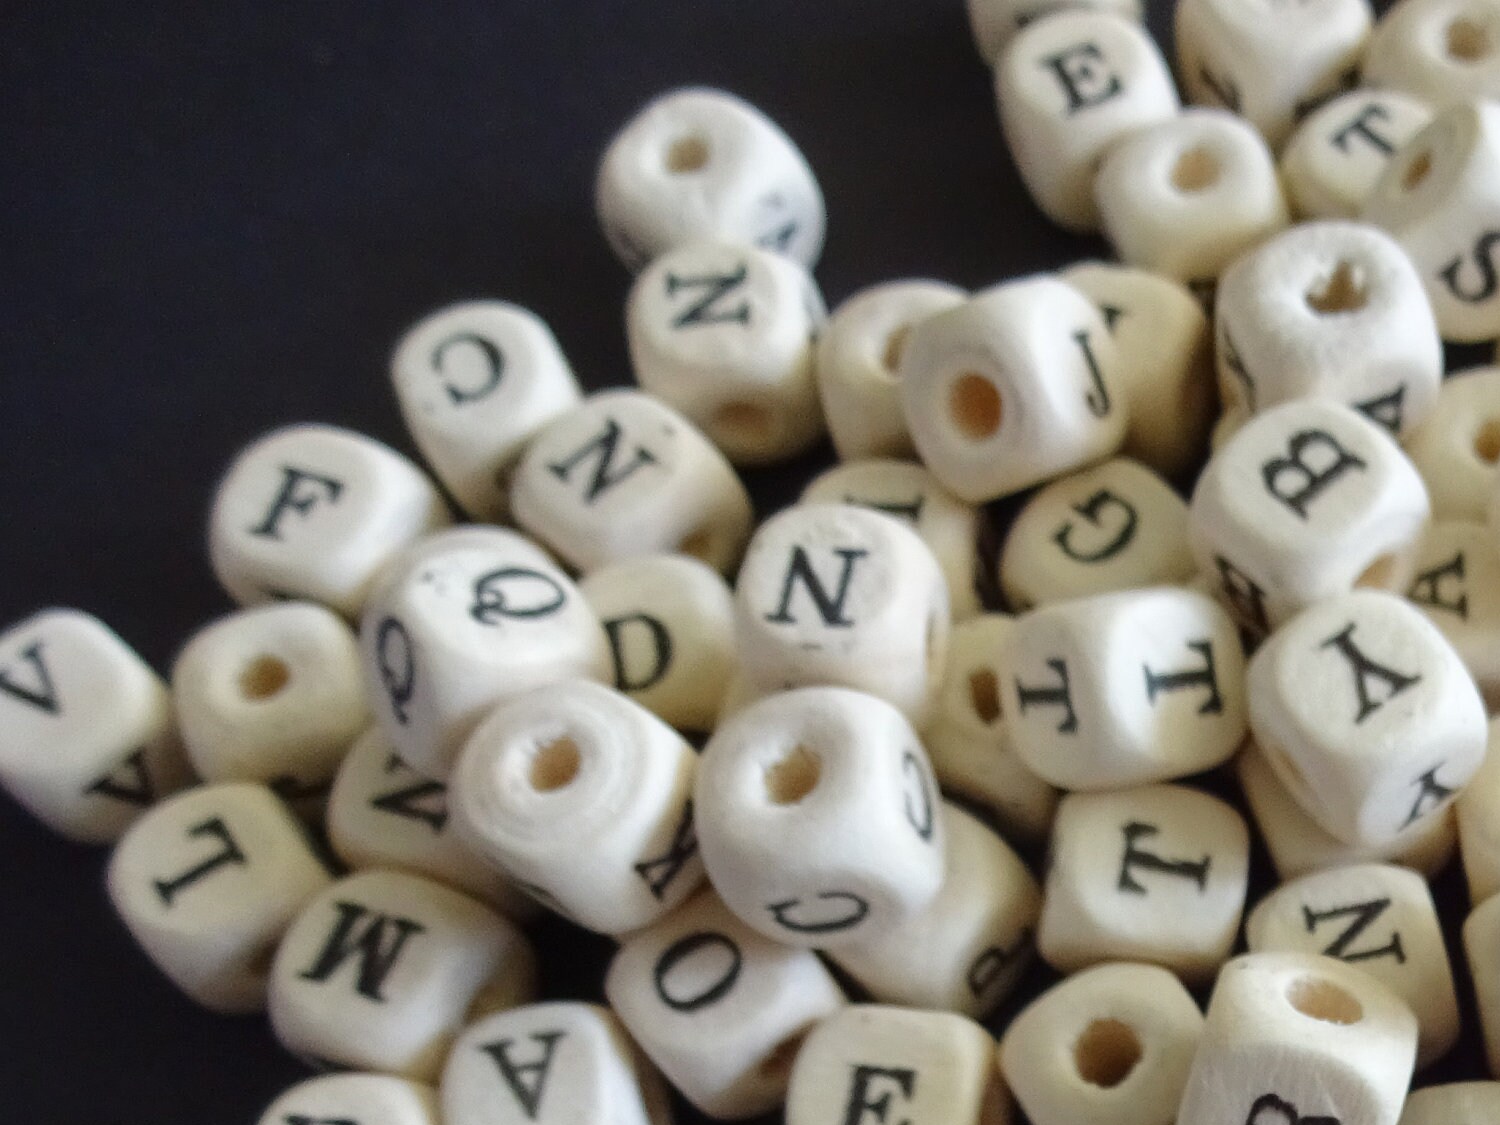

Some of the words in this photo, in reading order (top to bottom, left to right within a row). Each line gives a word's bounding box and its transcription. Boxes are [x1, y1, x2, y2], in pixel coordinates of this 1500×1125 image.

[1042, 43, 1124, 115] E
[1332, 104, 1396, 157] T
[664, 263, 751, 331] N
[432, 332, 503, 407] C
[1072, 331, 1112, 418] J
[549, 420, 660, 504] N
[1261, 427, 1368, 521] B
[246, 468, 345, 541] F
[1054, 488, 1140, 564] G
[468, 566, 567, 626] Q
[766, 544, 868, 626] N
[1408, 551, 1470, 624] A
[375, 615, 415, 724] Q
[603, 612, 673, 693] D
[1141, 639, 1224, 720] T
[1319, 622, 1422, 727] Y
[1015, 656, 1078, 736] T
[1116, 820, 1213, 897] T
[297, 901, 425, 1003] M
[767, 892, 870, 934] C
[1303, 897, 1406, 966] N
[653, 931, 743, 1012] O
[479, 1029, 569, 1121] A
